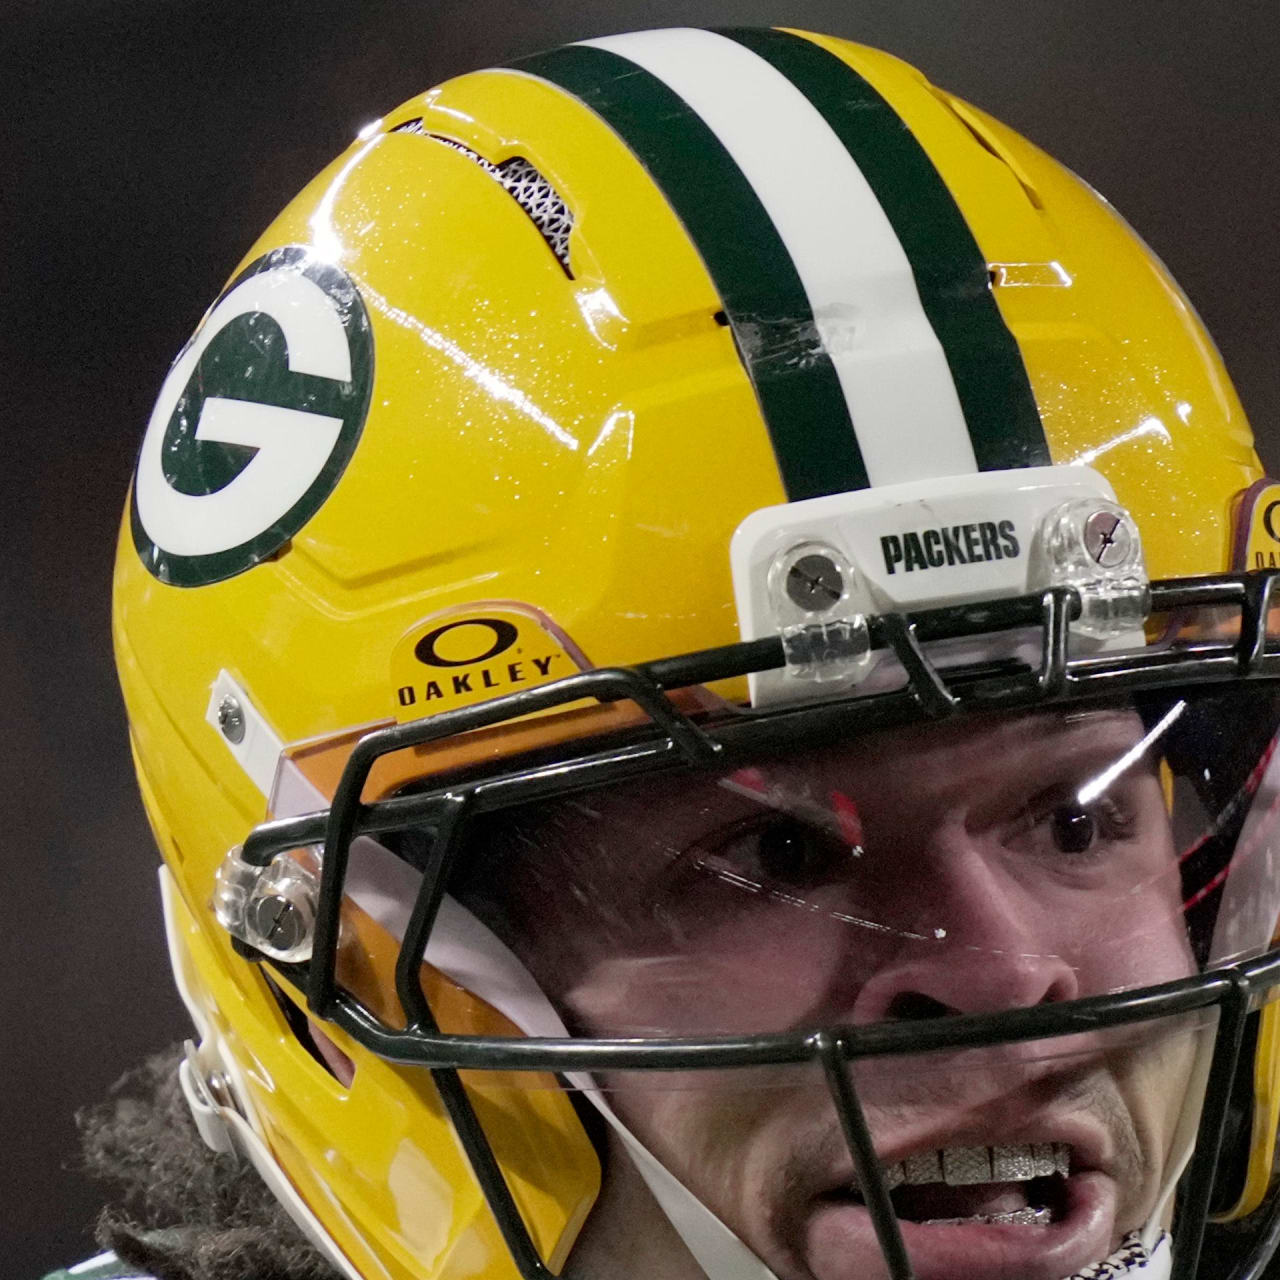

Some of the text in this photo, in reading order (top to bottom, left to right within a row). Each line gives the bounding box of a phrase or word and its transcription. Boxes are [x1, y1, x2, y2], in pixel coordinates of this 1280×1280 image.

[136, 267, 352, 557] G
[880, 520, 1020, 575] PACKERS
[398, 655, 553, 706] OAKLEY
